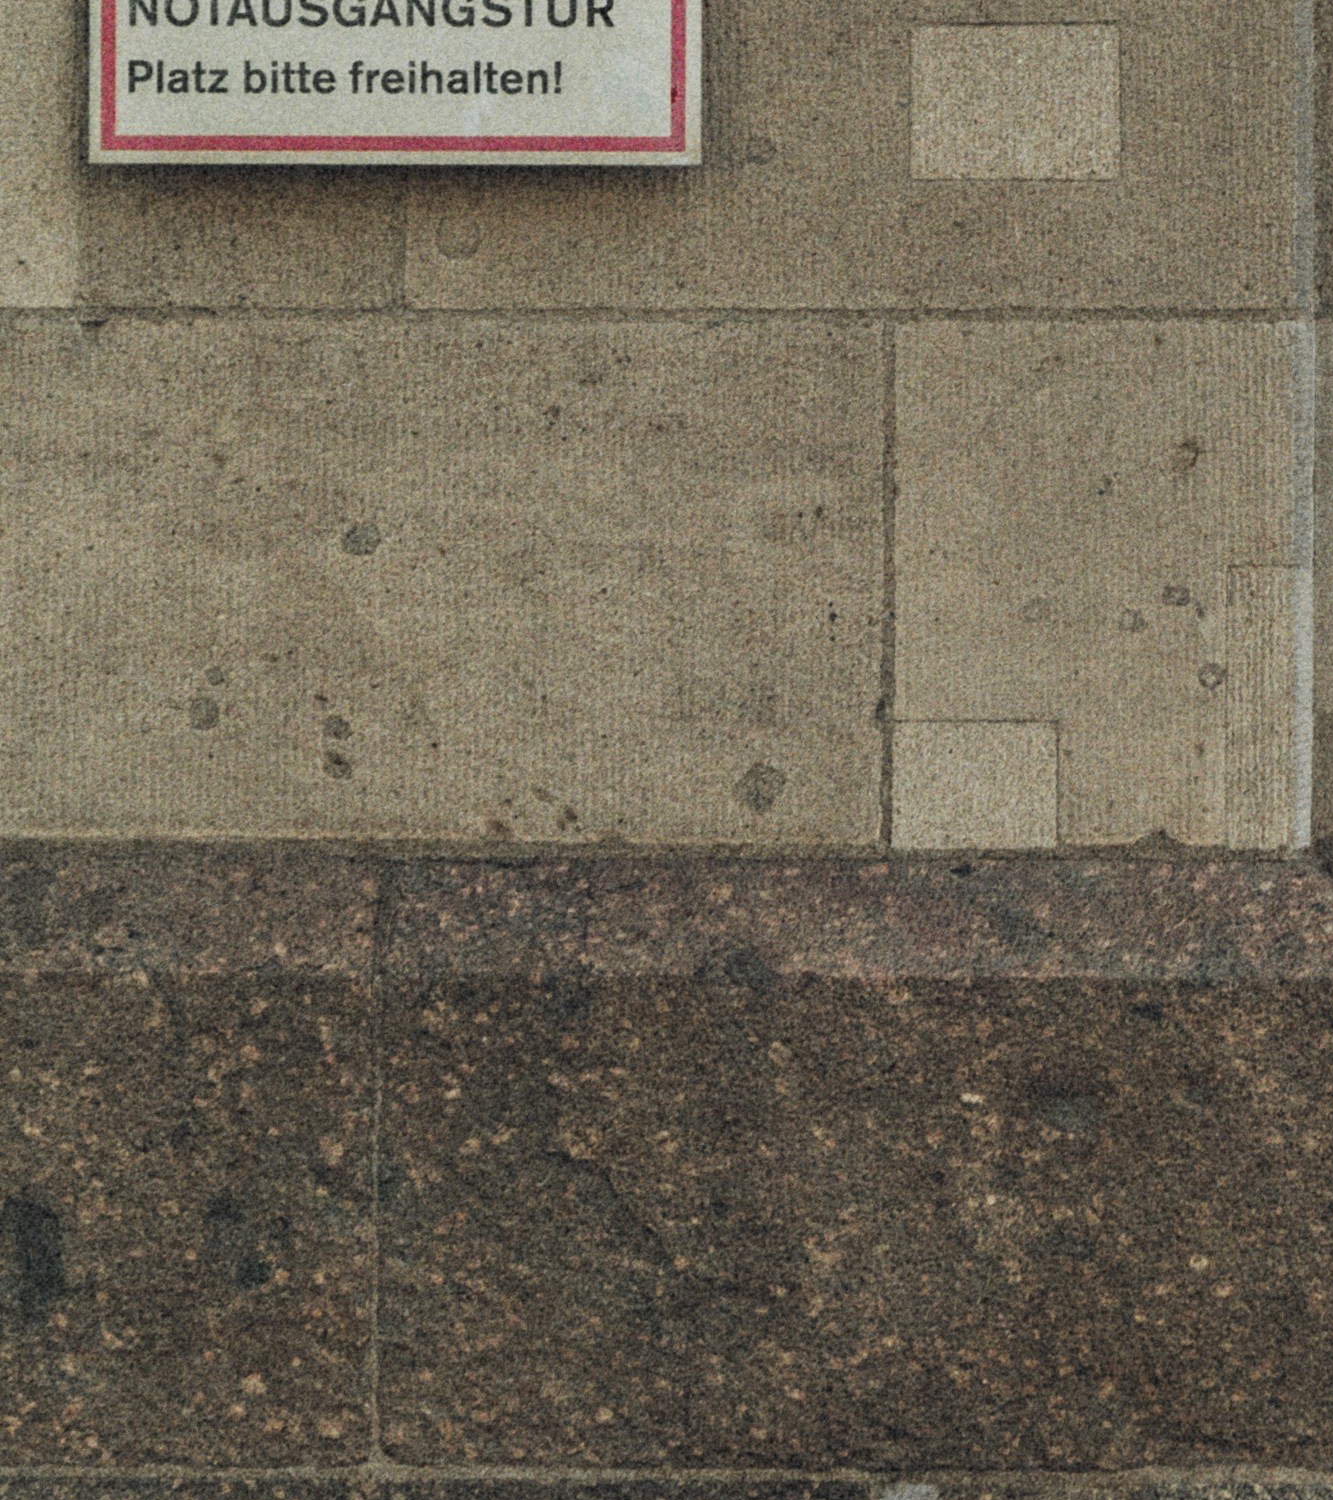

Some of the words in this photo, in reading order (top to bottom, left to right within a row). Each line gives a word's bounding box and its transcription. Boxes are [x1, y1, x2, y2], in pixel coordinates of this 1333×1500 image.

[127, 59, 229, 95] Platz
[244, 59, 337, 95] bitte
[348, 59, 563, 95] freihalten!
